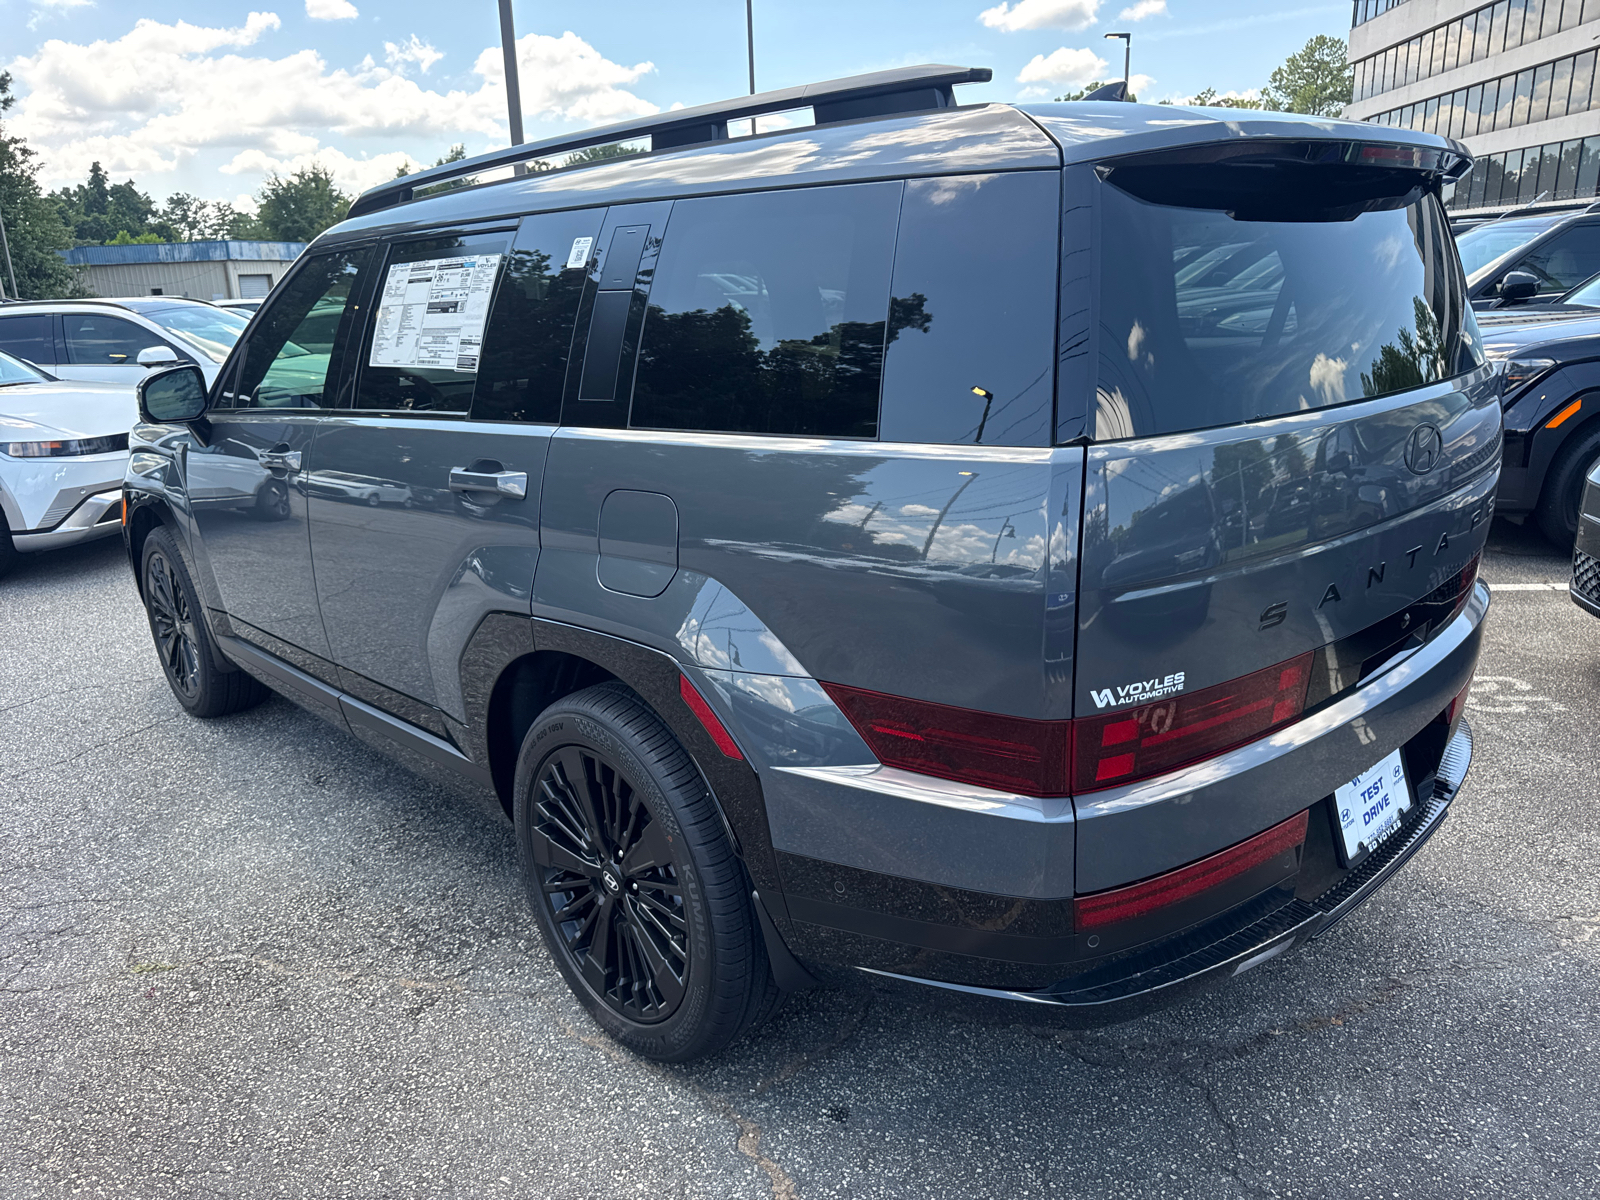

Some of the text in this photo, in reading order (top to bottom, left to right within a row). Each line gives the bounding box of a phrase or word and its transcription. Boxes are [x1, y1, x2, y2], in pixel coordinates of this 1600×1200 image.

[1258, 532, 1450, 632] SANTA
[1116, 671, 1185, 697] VOYLES
[1117, 683, 1184, 705] AUTOMOTIVE
[548, 722, 564, 733] 105V
[1360, 776, 1383, 804] TEST
[1362, 793, 1391, 826] DRIVE
[1368, 819, 1402, 853] ED VOYLES
[682, 863, 707, 960] KUMHO
